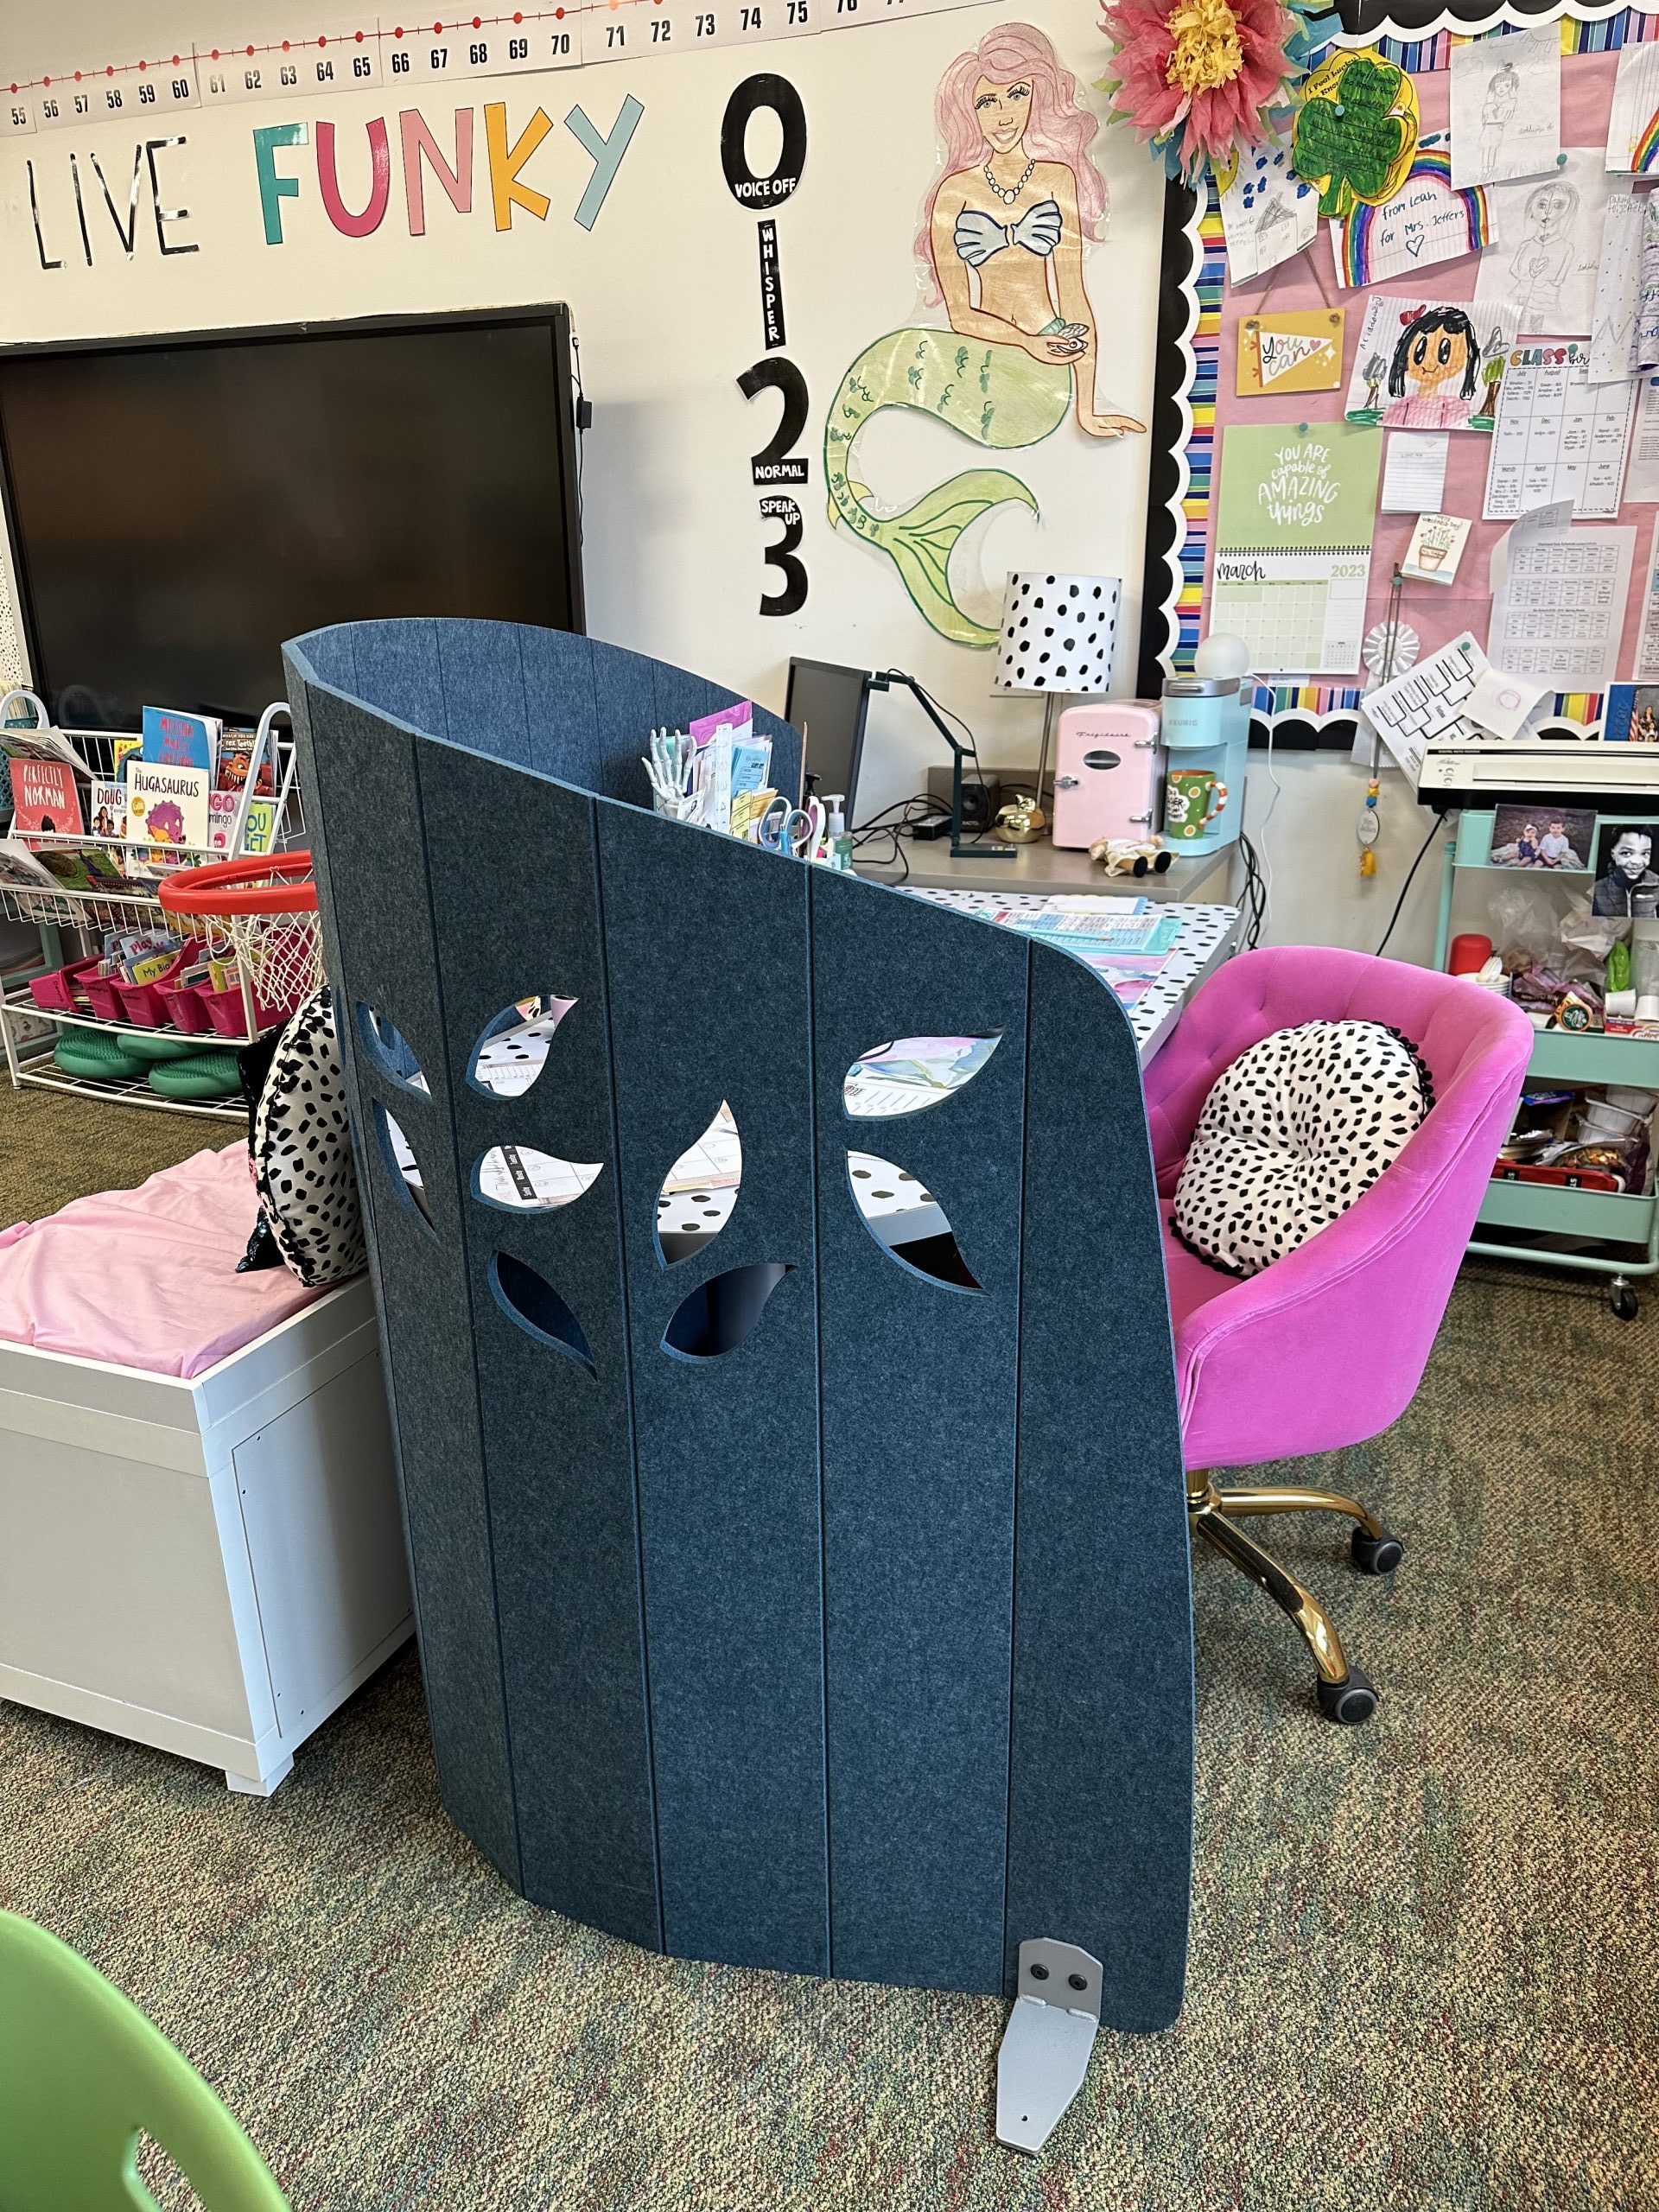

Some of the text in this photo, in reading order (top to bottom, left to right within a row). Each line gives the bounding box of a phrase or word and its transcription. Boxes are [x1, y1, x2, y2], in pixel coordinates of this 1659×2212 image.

[607, 0, 808, 48] 71 72 73 74 75
[391, 34, 570, 73] 66 67 68 69 70
[210, 56, 372, 93] 61 62 63 64 65
[1313, 76, 1331, 90] Feel
[11, 79, 189, 125] 55 56 57 58 59 60
[27, 93, 645, 270] LIVE FUNKY
[734, 177, 796, 198] VOICE OFF
[1382, 203, 1406, 220] from
[1381, 229, 1395, 247] for
[1432, 210, 1465, 226] Jeffers
[760, 226, 780, 341] WHISPER
[1262, 336, 1303, 364] you
[1269, 346, 1311, 376] can
[1510, 348, 1567, 366] CLASS
[736, 356, 810, 486] 2
[1274, 443, 1332, 465] YOU ARE
[754, 464, 805, 480] NORMAL
[1271, 460, 1332, 480] capable of
[1258, 475, 1341, 505] AMAZING
[761, 499, 796, 514] SPEAK
[785, 512, 801, 525] UP
[1267, 499, 1325, 526] things
[759, 495, 809, 616] 3
[1217, 561, 1266, 582] march
[1331, 564, 1366, 578] 2023
[23, 764, 63, 789] PERFECTLY
[135, 773, 200, 798] HUGASAURUS
[24, 785, 66, 810] NORMAN
[97, 788, 122, 805] DOUG
[129, 938, 153, 956] Play
[142, 965, 156, 977] My
